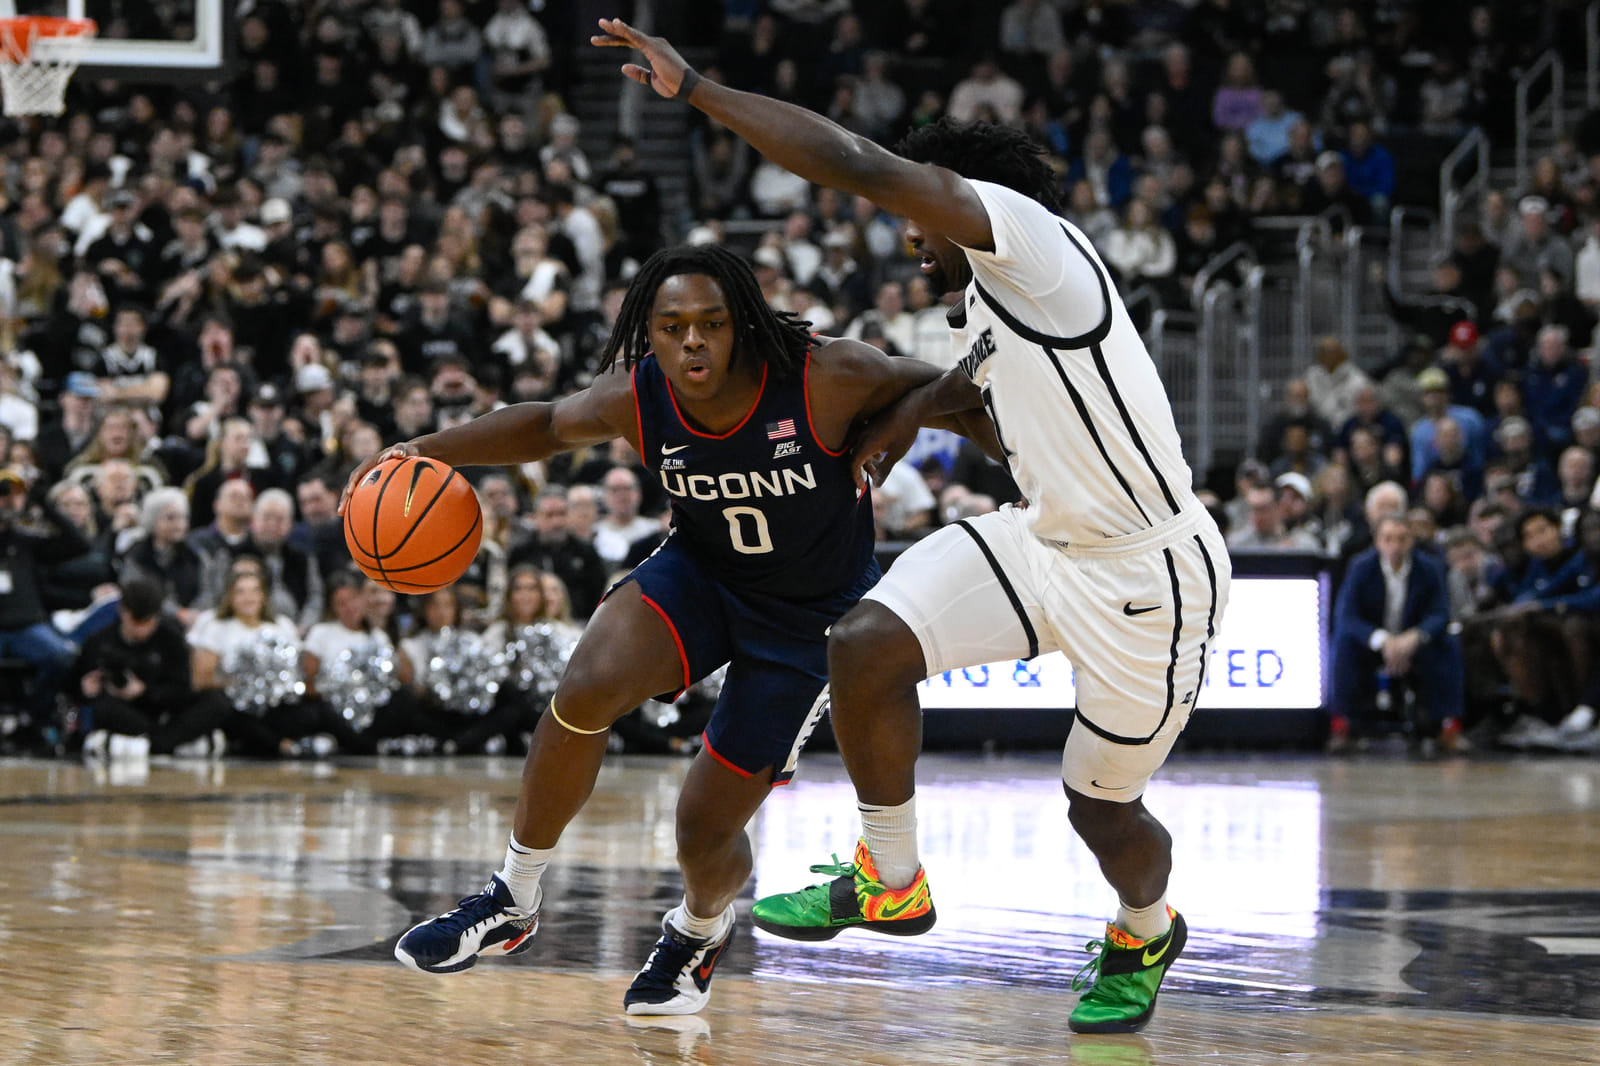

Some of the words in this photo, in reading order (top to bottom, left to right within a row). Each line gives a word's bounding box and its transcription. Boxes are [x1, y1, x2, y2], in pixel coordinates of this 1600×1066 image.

[775, 446, 802, 456] EAST
[777, 441, 796, 449] BIG
[660, 463, 817, 500] UCONN
[722, 506, 774, 554] 0
